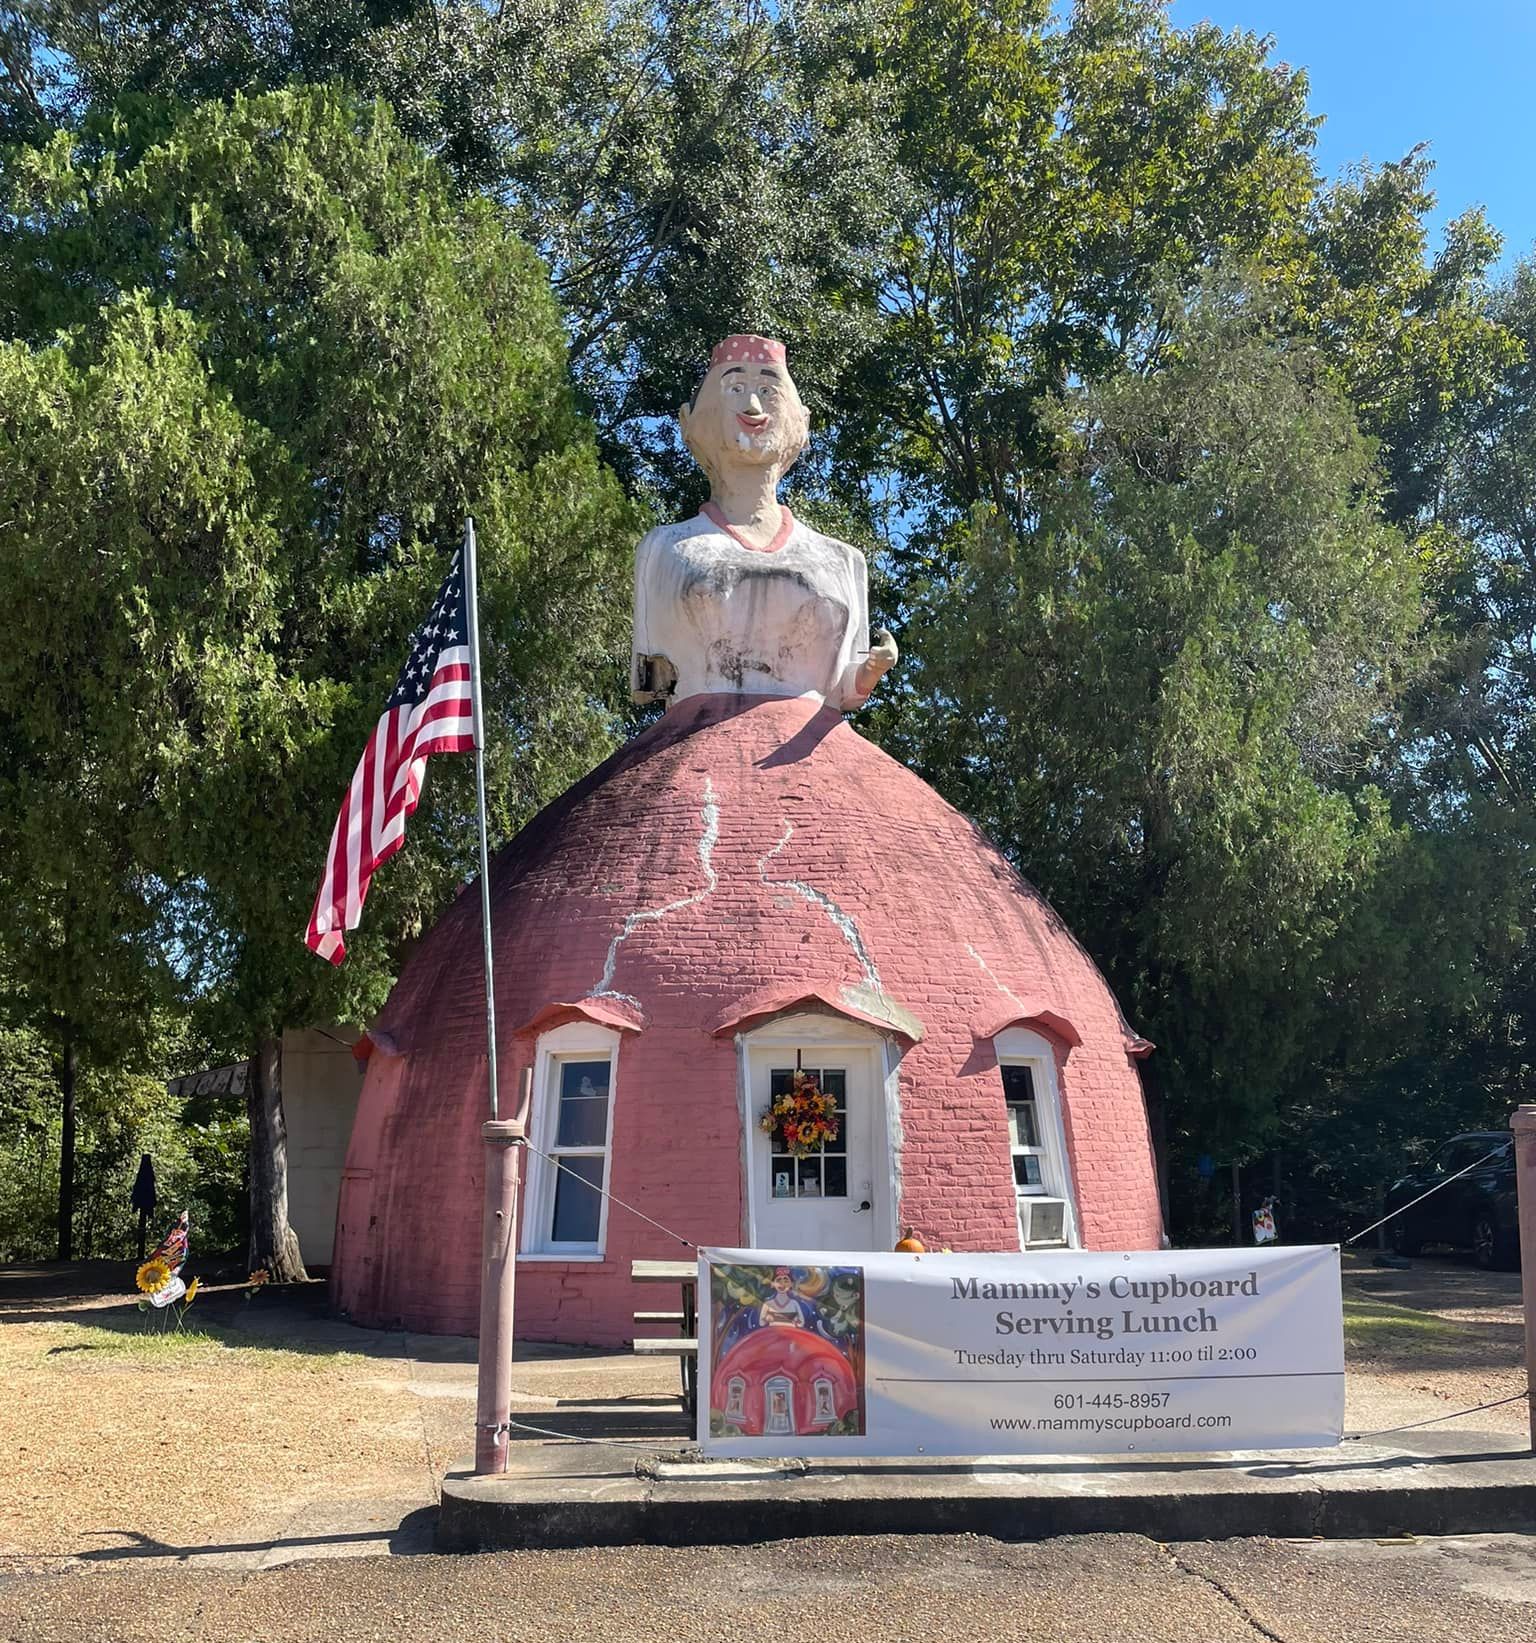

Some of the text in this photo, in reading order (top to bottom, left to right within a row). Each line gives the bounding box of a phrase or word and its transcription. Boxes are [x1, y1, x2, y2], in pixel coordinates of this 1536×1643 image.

[951, 1272, 1260, 1306] Mammy's Cupboard
[995, 1308, 1219, 1340] Serving Lunch
[955, 1347, 1257, 1368] Tuesday thru Saturday 11:00 til 2:00
[1054, 1393, 1171, 1410] 601-445-8957
[990, 1414, 1232, 1433] www.mammyscupboard.com
